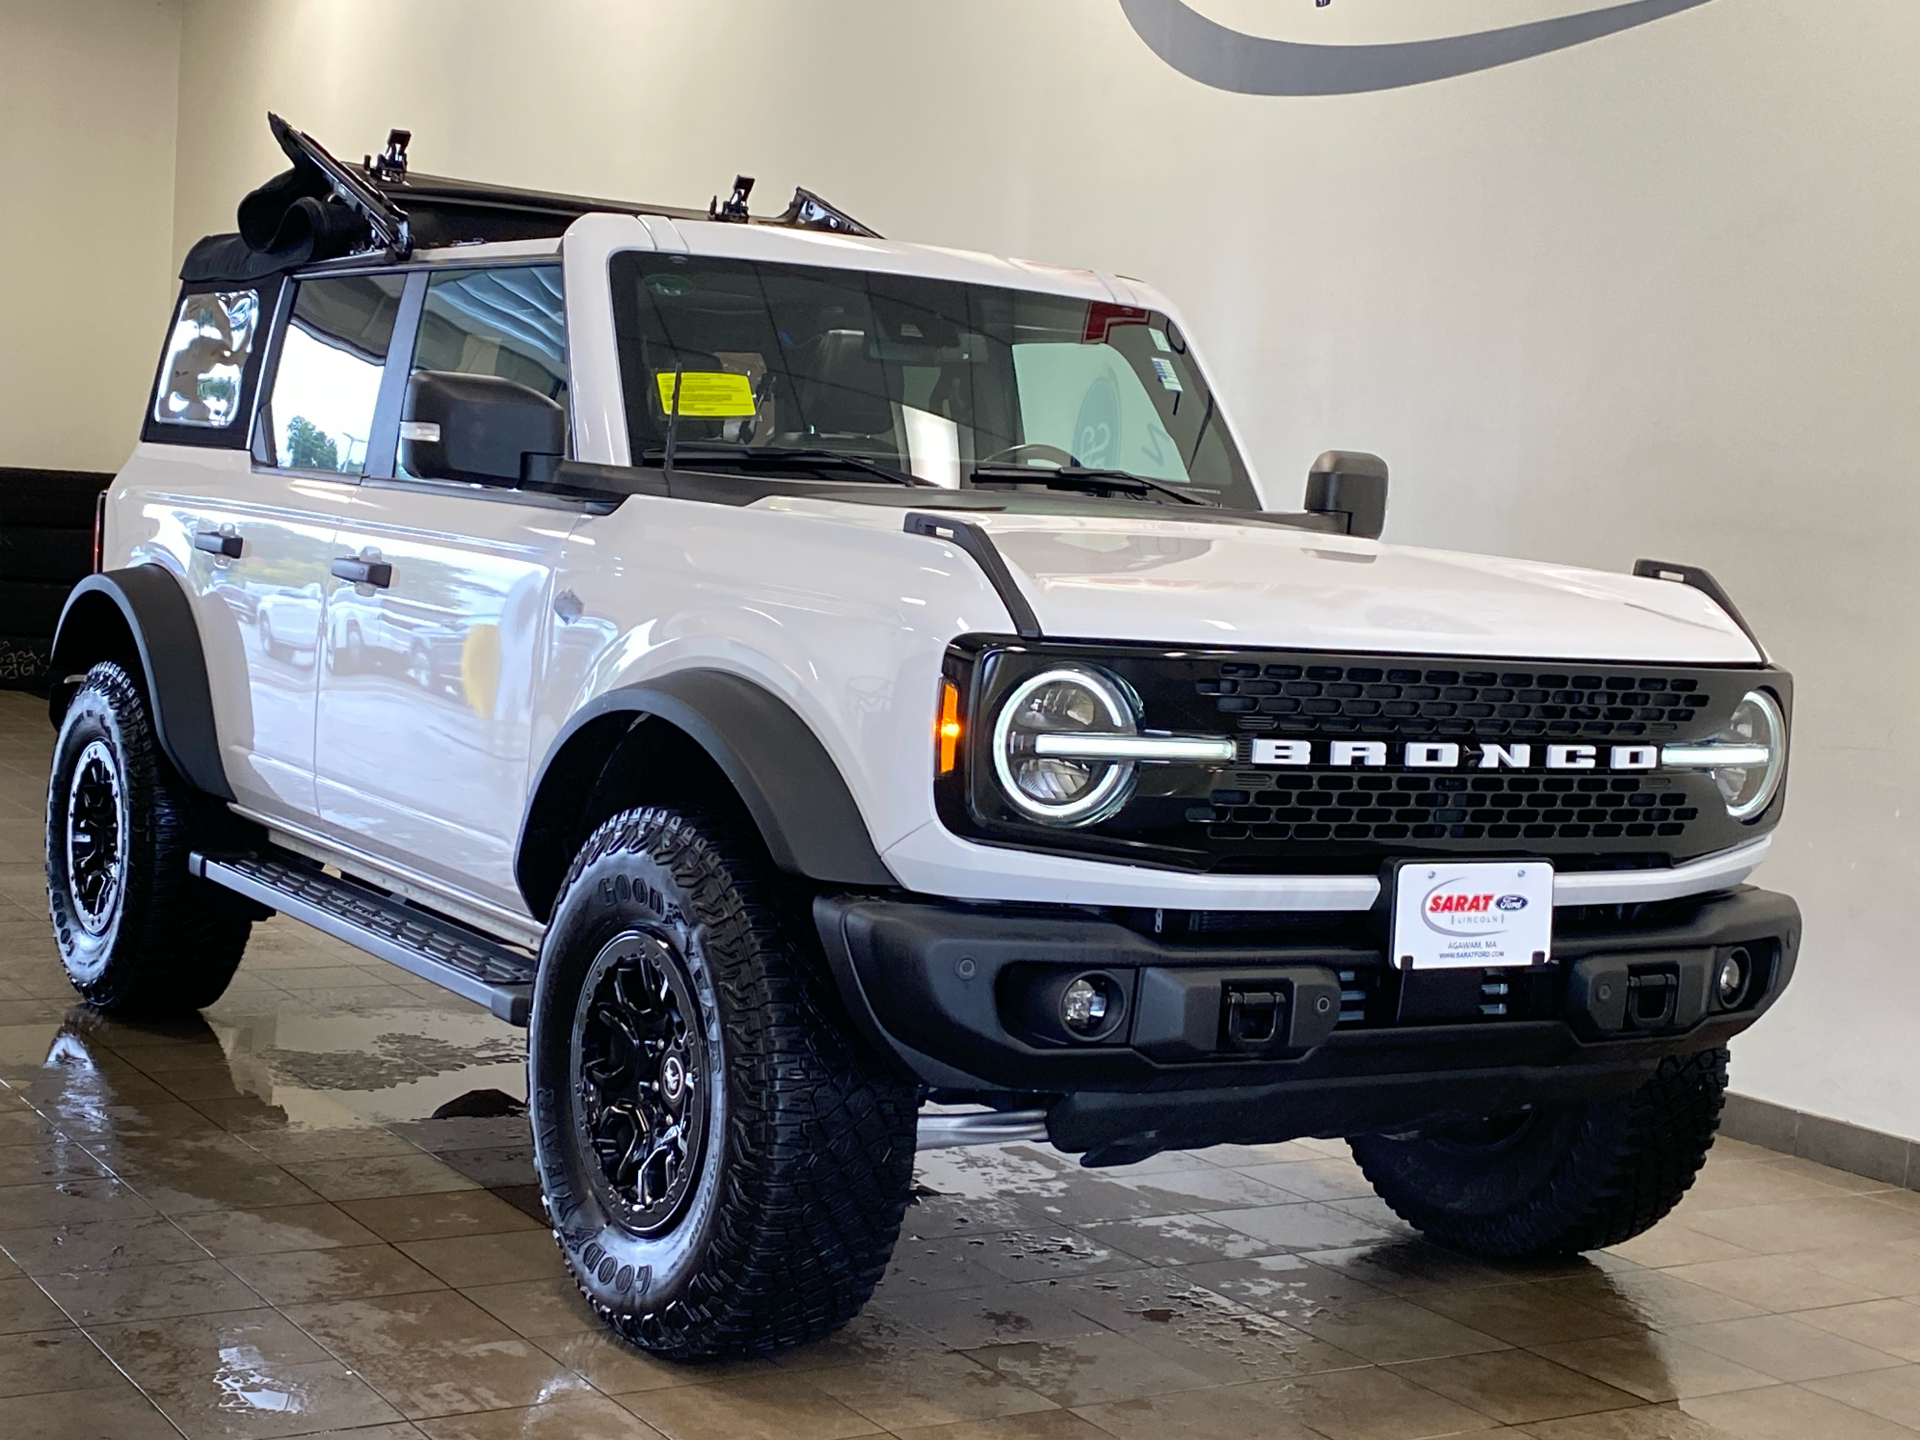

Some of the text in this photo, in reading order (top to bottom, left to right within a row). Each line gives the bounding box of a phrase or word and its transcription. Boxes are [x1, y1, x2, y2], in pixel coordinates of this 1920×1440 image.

[1251, 738, 1658, 769] BRONCO
[1428, 893, 1524, 913] SARAT Ford
[1457, 915, 1498, 924] LINCOLN
[1485, 941, 1497, 949] MA
[1439, 951, 1505, 959] WWW.SARATFORD.COM
